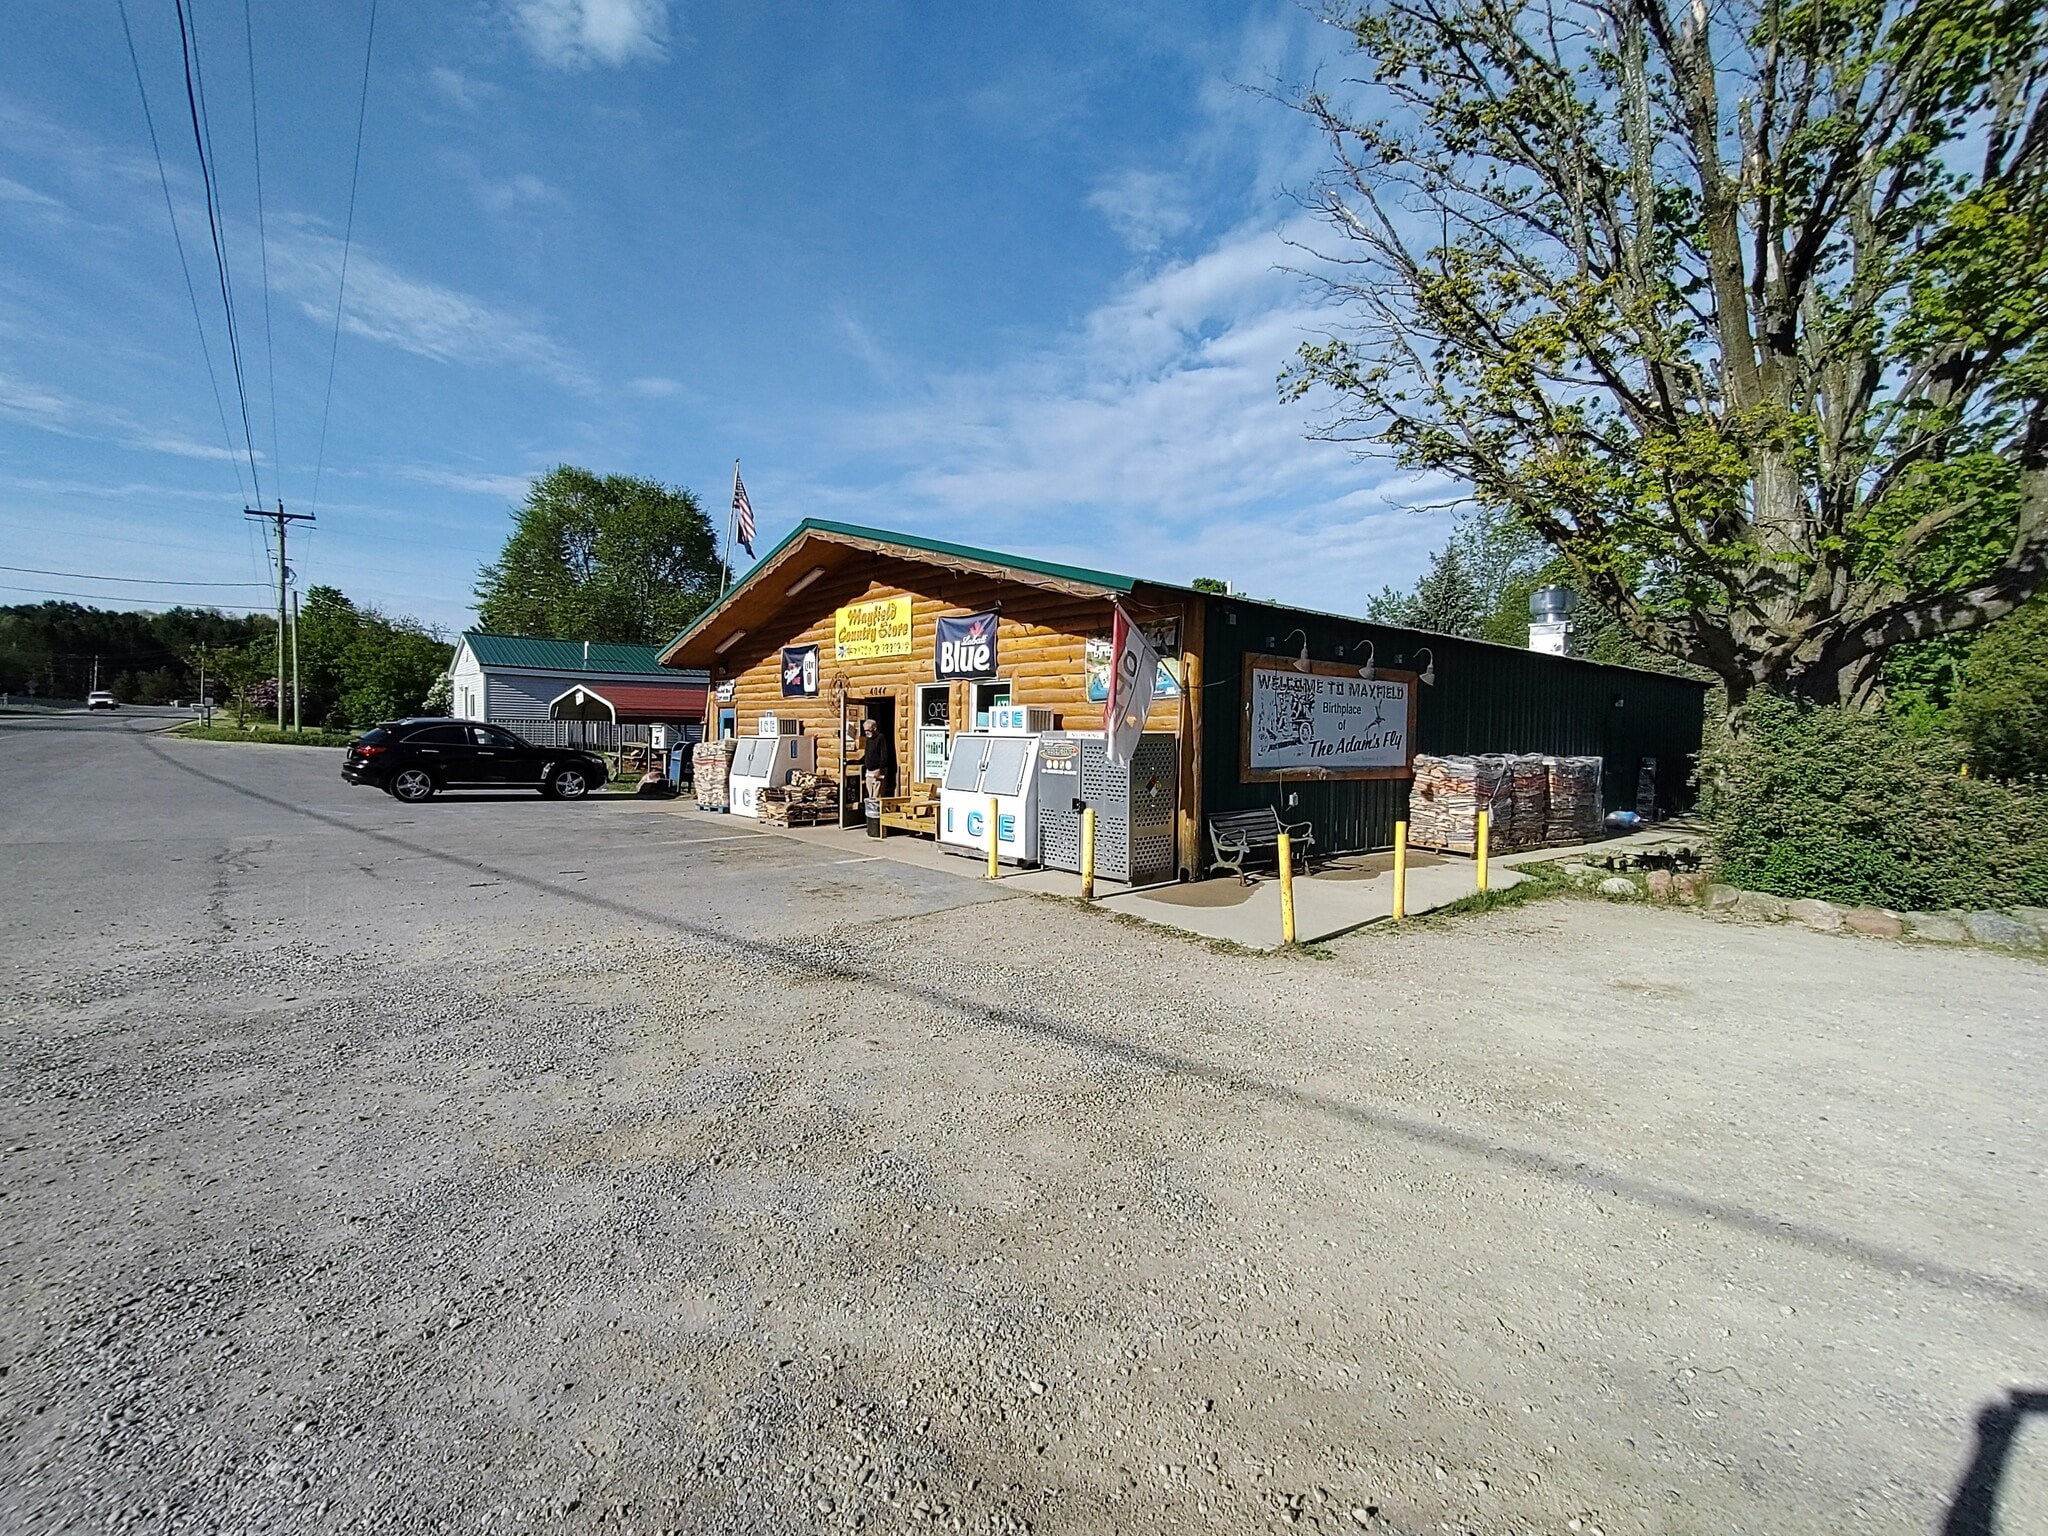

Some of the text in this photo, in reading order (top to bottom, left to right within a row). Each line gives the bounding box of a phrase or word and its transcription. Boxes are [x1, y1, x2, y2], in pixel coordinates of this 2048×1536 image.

[941, 640, 990, 673] Blue
[1257, 674, 1404, 700] WELCOME TO MAYFIELD
[928, 702, 948, 717] OPE
[1322, 701, 1362, 717] Birthplace
[760, 720, 776, 733] ICE
[991, 710, 1023, 728] ICE
[1337, 719, 1346, 731] of
[1309, 730, 1402, 758] The Adam's Fly
[947, 807, 1016, 842] ICE
